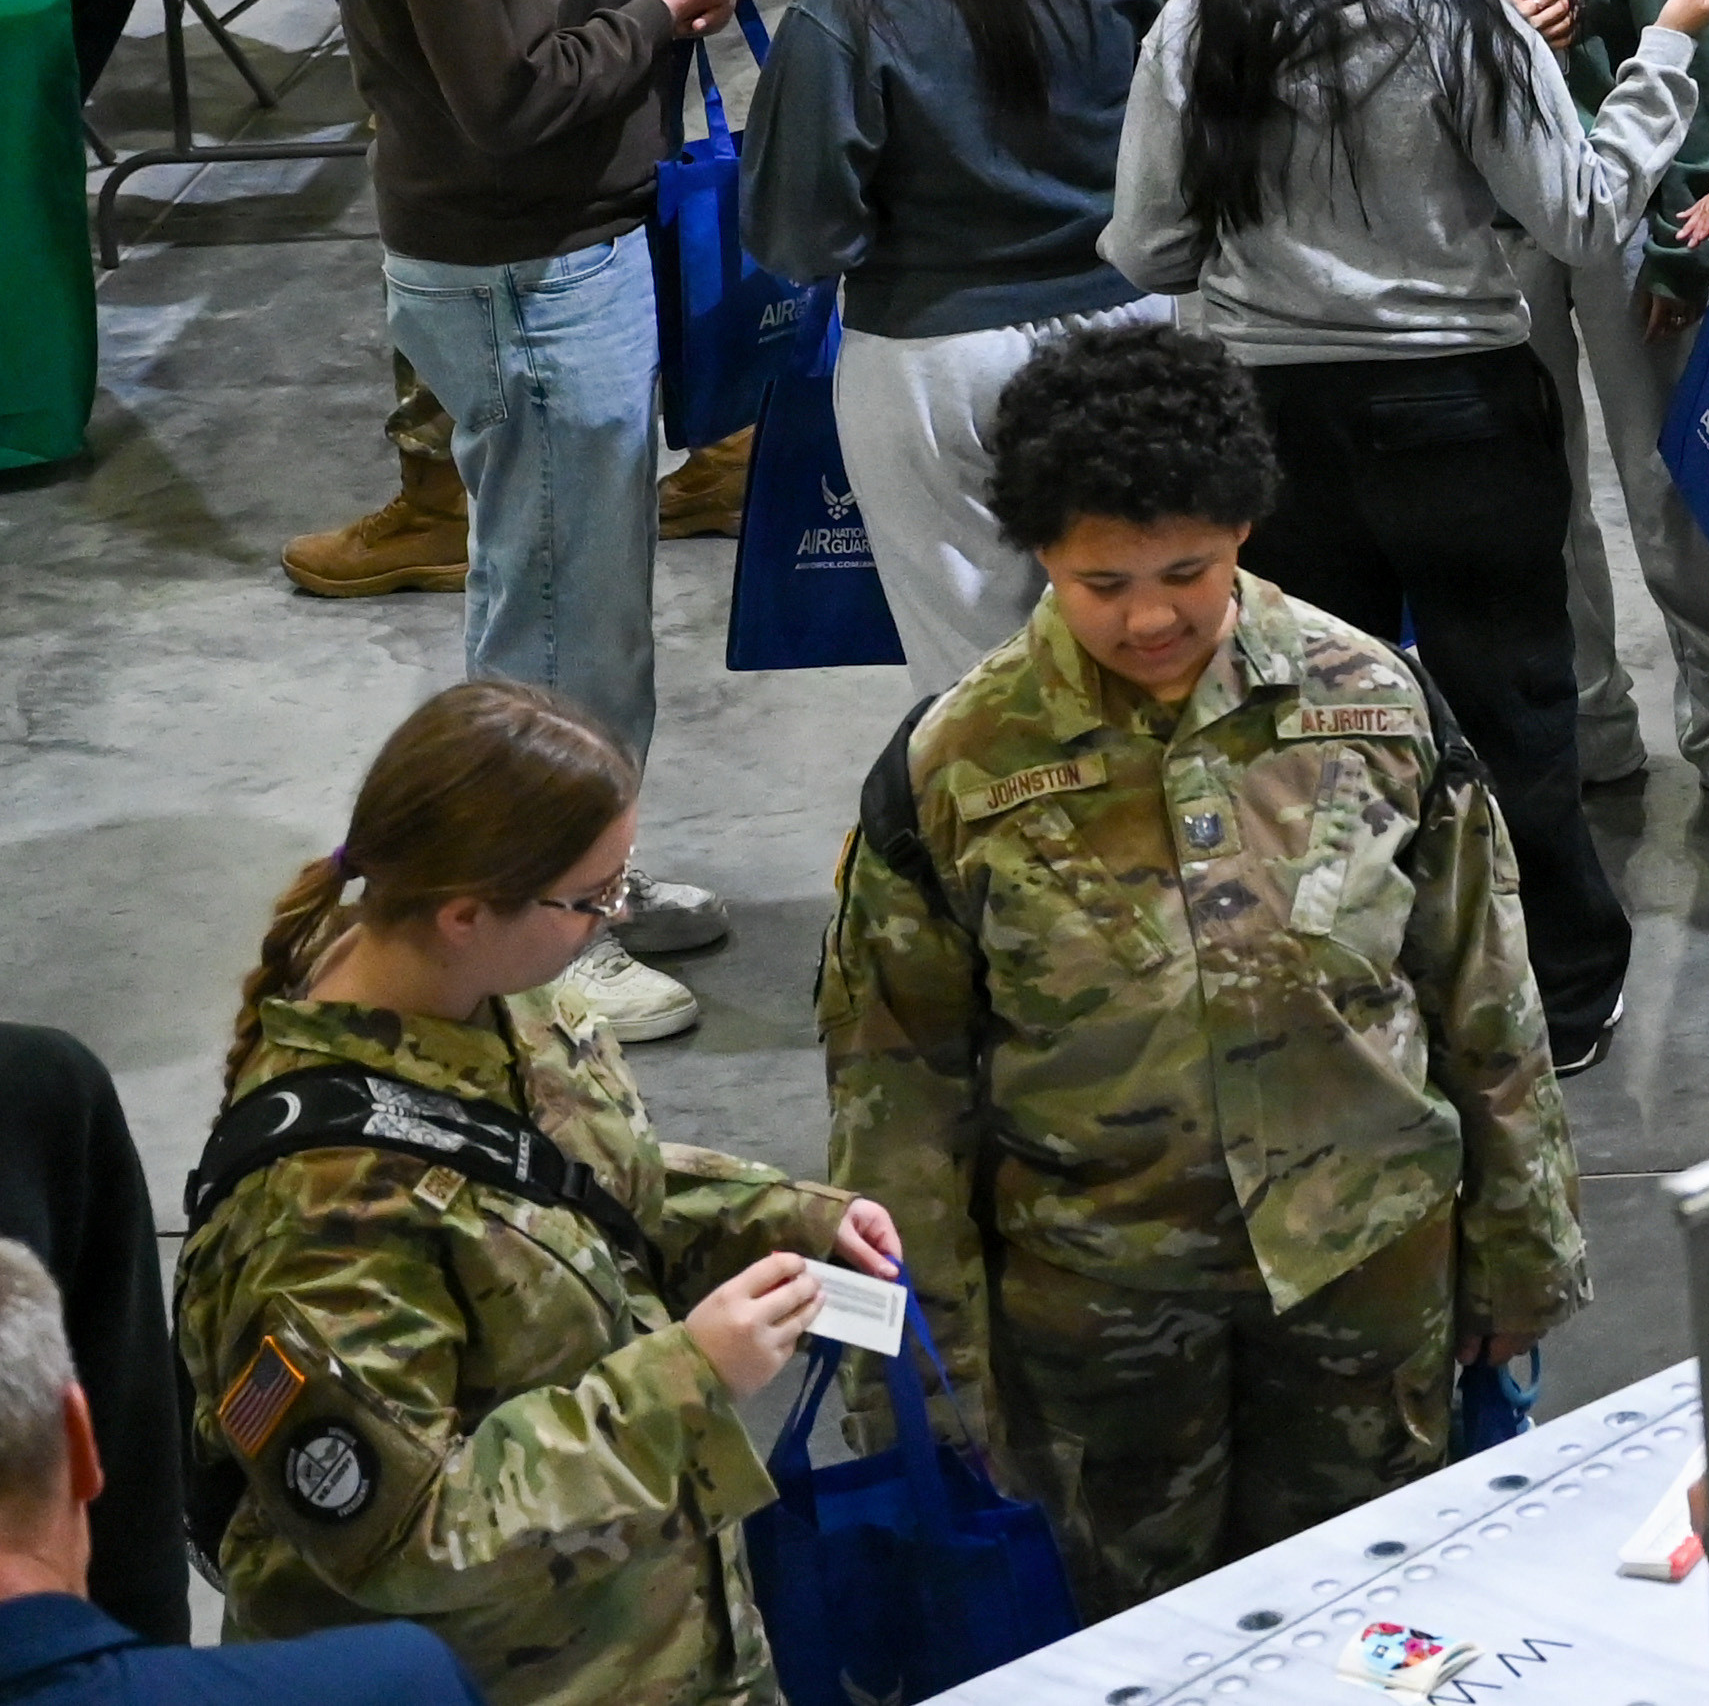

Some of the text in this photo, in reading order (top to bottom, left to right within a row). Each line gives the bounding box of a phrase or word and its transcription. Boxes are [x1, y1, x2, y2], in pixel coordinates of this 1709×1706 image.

[760, 299, 795, 331] AIR
[797, 529, 832, 556] AIR
[831, 539, 874, 554] GUAR
[1301, 710, 1390, 735] AFJROTC
[987, 767, 1082, 811] JOHNSTON
